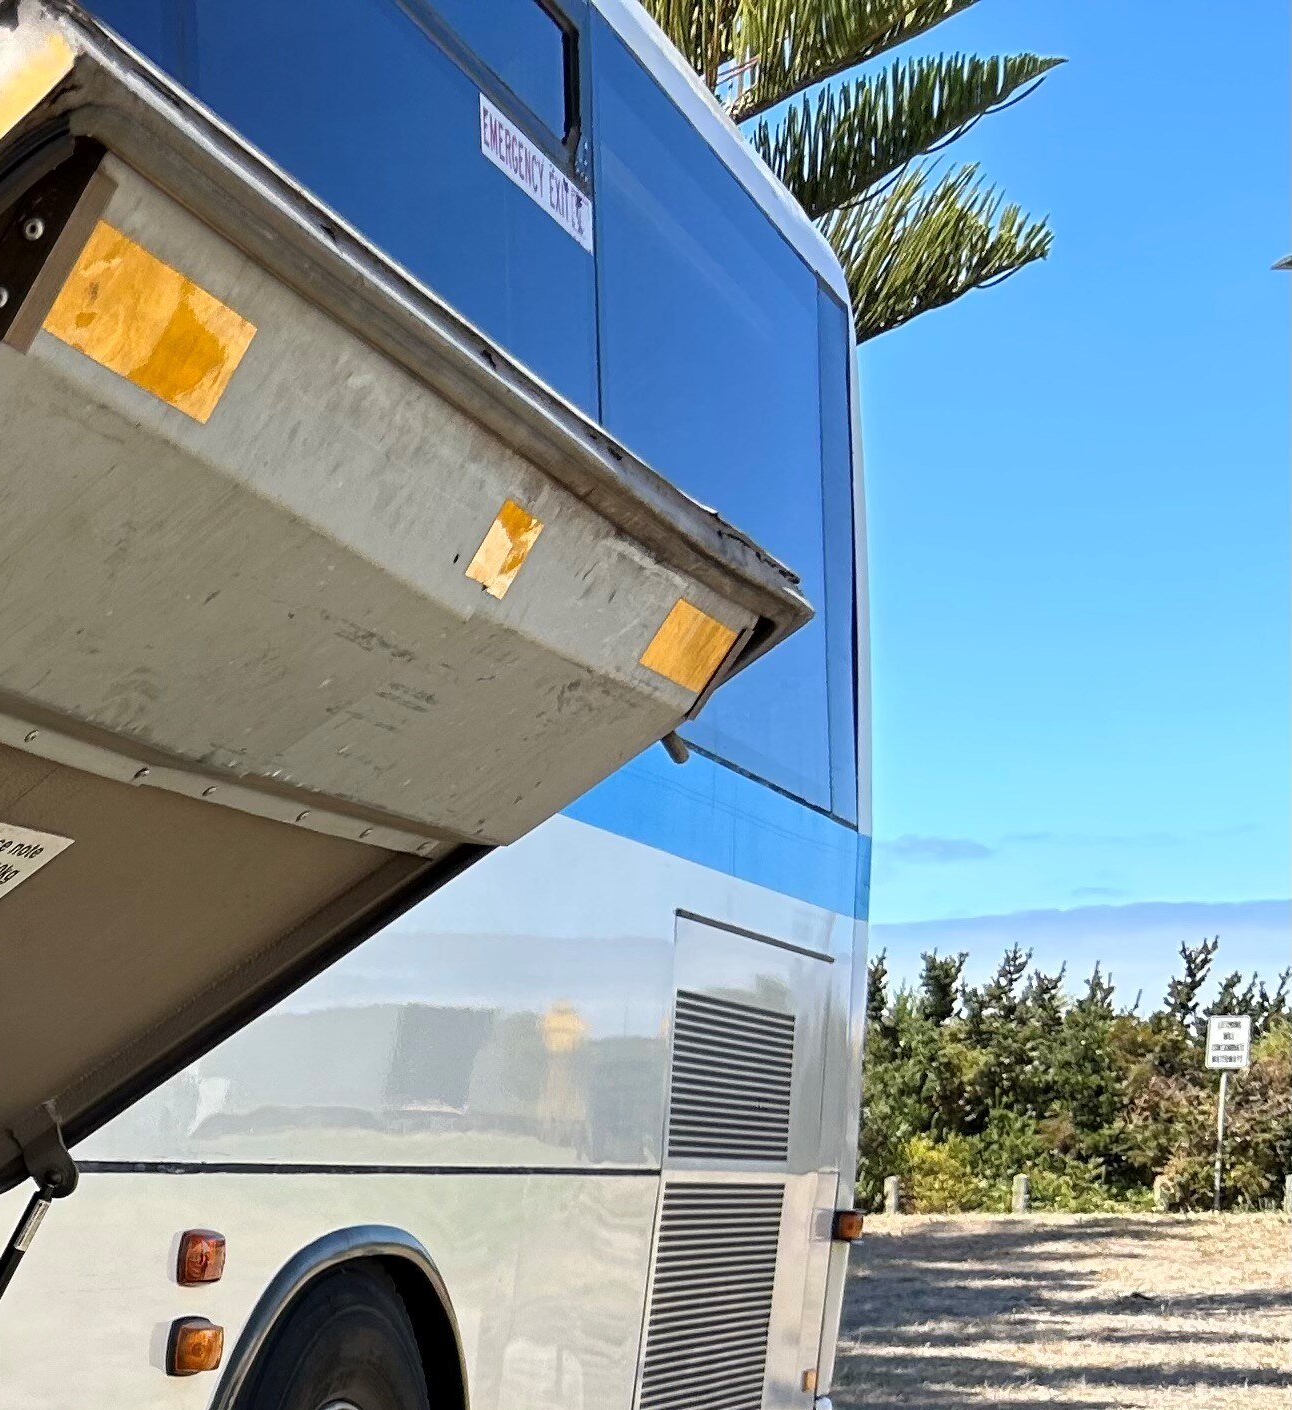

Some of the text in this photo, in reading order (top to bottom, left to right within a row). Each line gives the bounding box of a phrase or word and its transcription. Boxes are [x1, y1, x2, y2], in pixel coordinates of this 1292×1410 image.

[483, 107, 544, 198] EMERGENCY
[549, 170, 570, 223] EXIT
[8, 843, 45, 859] note
